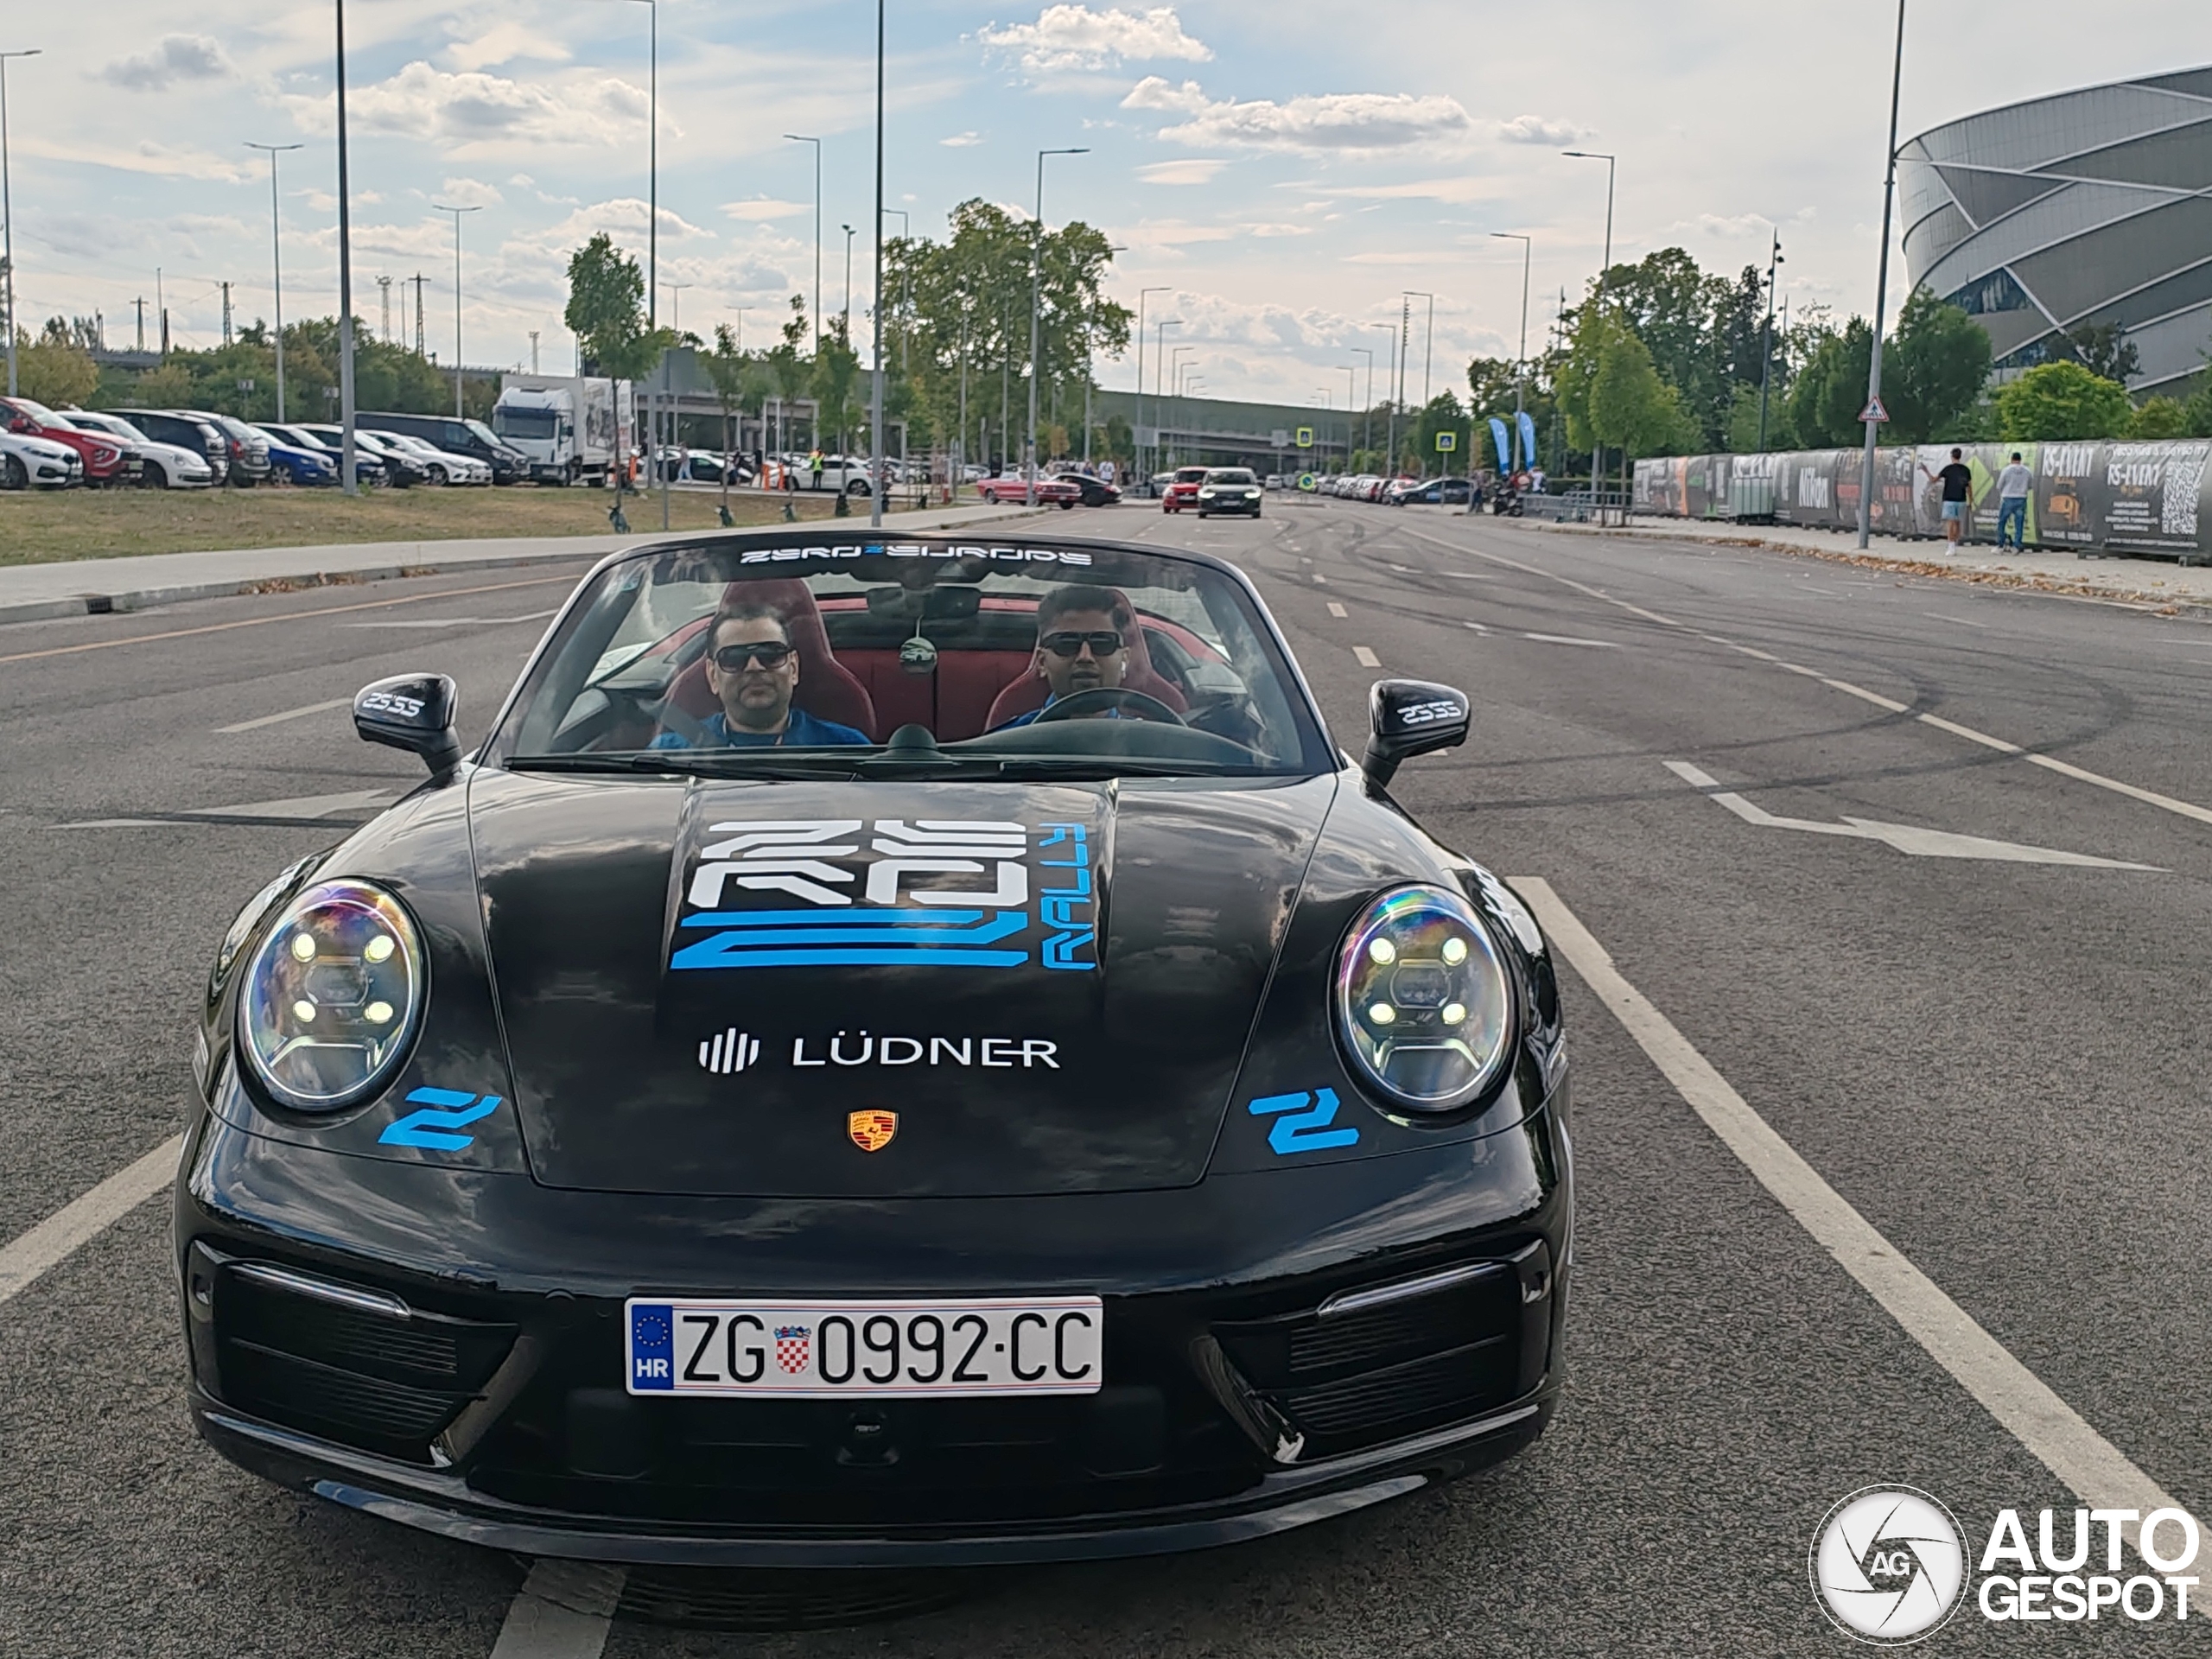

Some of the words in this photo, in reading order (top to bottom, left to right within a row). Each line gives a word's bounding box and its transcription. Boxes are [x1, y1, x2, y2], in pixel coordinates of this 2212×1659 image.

[1798, 465, 1829, 509] Nikon
[1039, 821, 1096, 970] RALLY
[792, 1030, 1060, 1069] LÜDNER
[636, 1358, 668, 1378] HR
[683, 1314, 765, 1383] ZG
